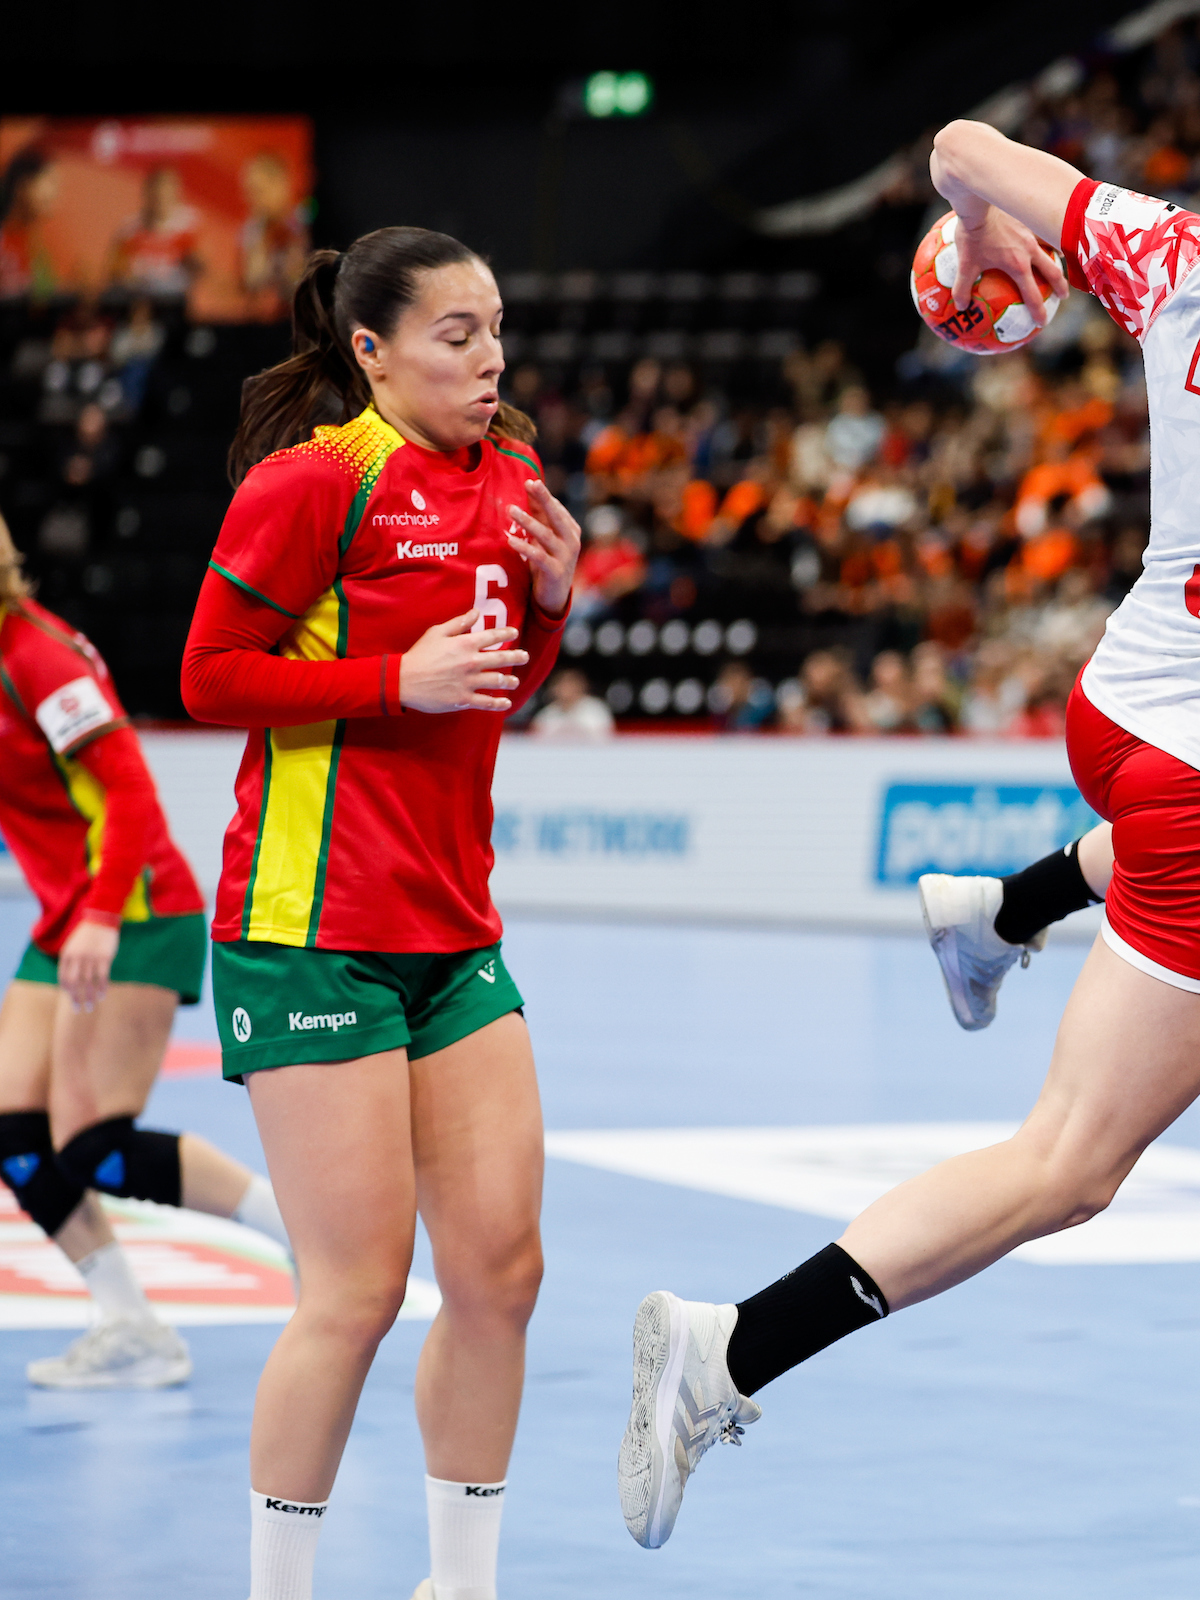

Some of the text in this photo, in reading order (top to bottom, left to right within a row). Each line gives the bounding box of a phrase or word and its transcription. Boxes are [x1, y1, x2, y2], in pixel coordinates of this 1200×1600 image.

[396, 540, 459, 561] Kempa
[470, 563, 508, 651] 6
[288, 1011, 357, 1032] Kempa
